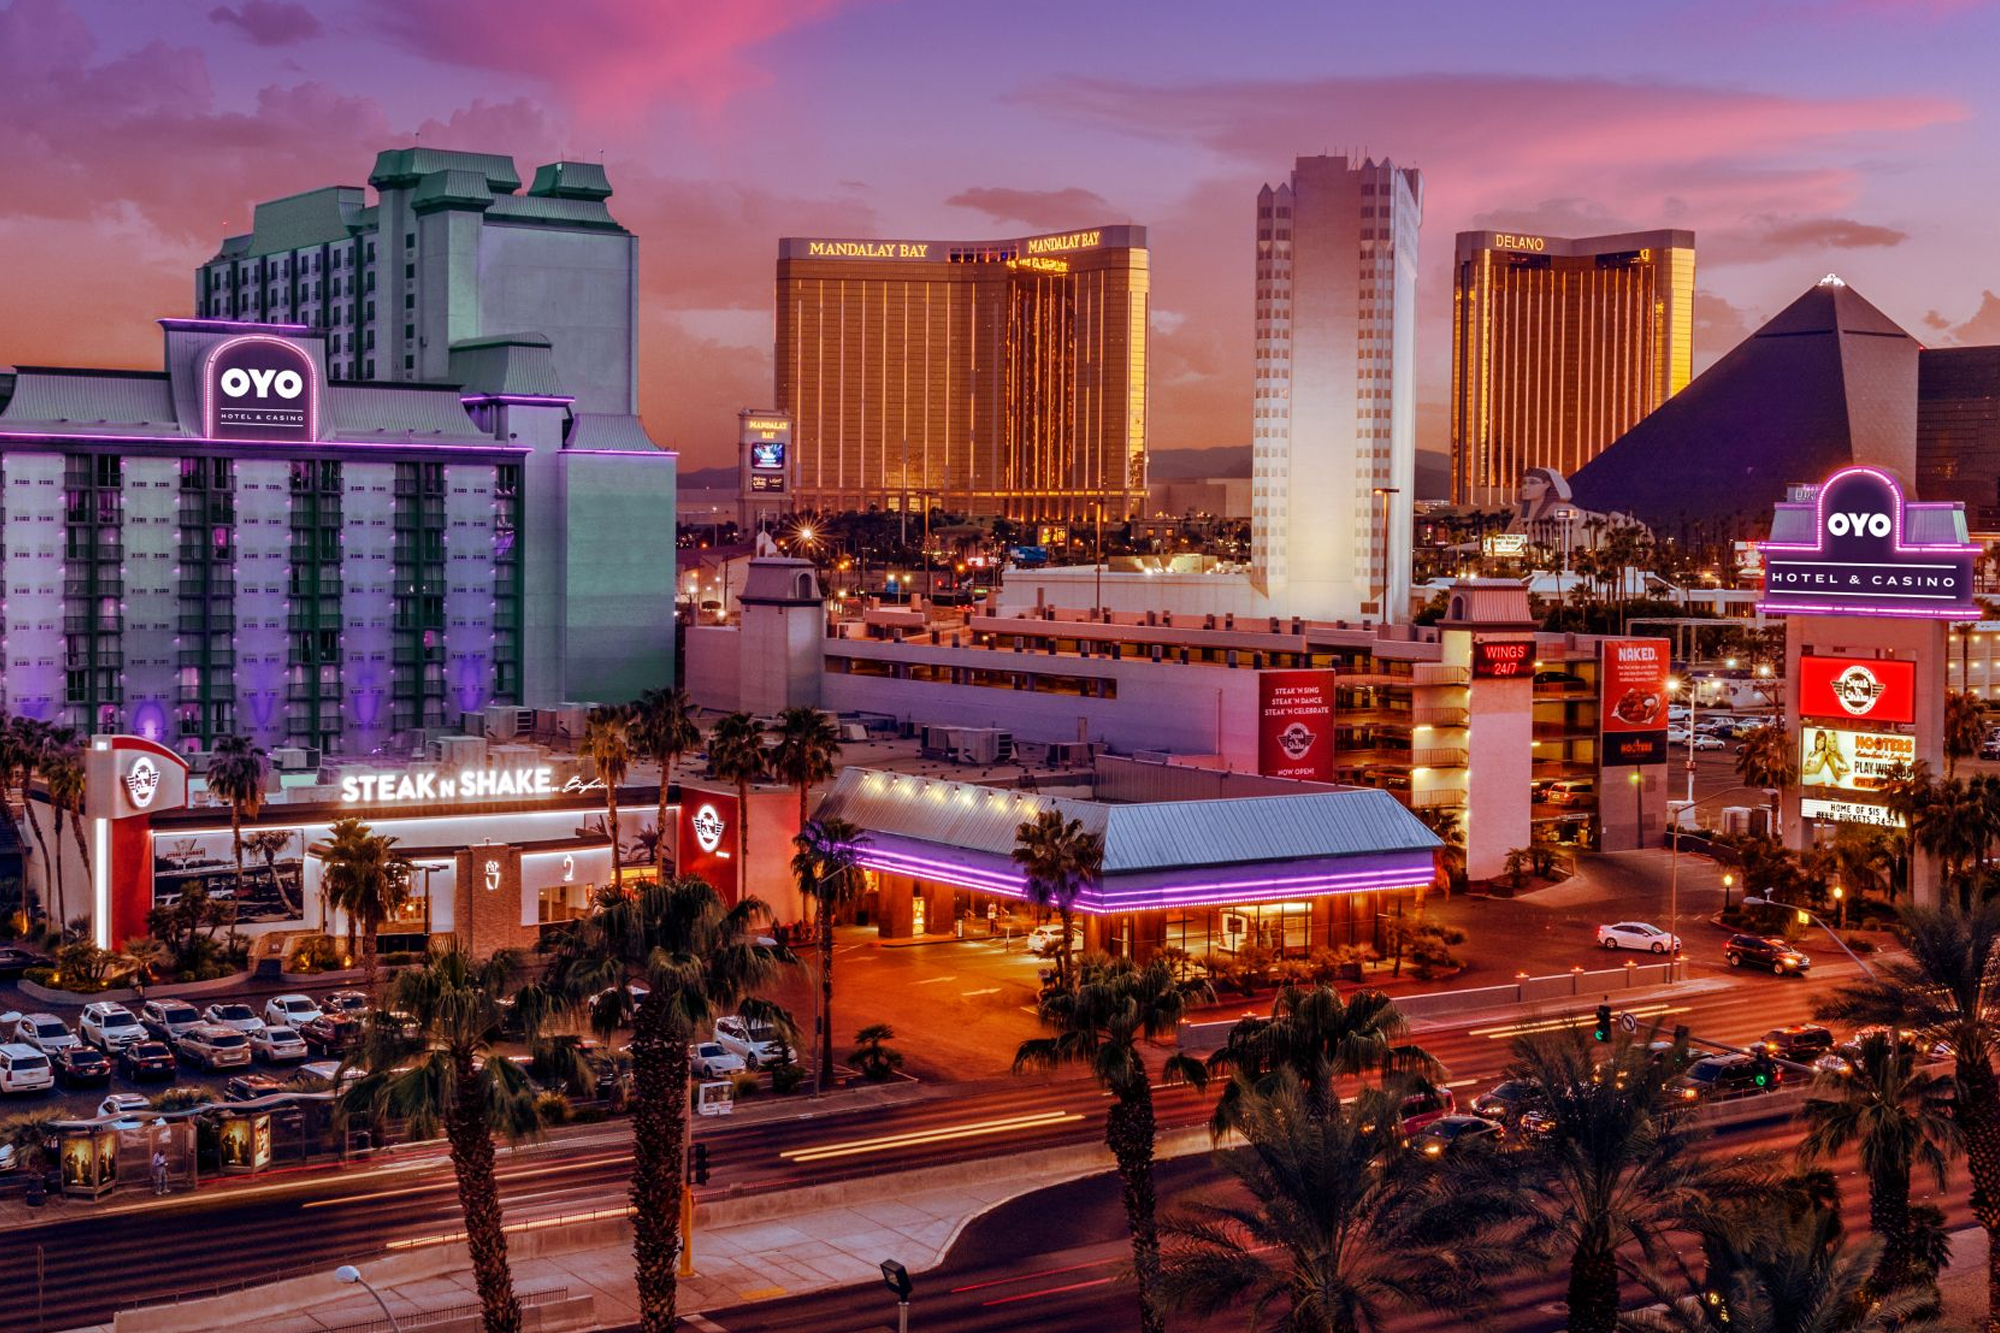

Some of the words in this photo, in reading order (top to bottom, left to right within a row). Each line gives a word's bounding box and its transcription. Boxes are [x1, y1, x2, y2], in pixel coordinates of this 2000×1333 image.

[1028, 234, 1081, 254] MANDALAY
[1082, 231, 1100, 247] BAY
[1495, 234, 1544, 251] DELANO
[809, 242, 896, 257] MANDALAY
[899, 243, 928, 258] BAY
[221, 368, 303, 399] OYO
[265, 413, 304, 421] CASINO
[749, 420, 788, 430] MANDALAY
[761, 431, 776, 439] BAY
[1828, 512, 1891, 538] OYO
[1771, 572, 1839, 584] HOTEL
[1849, 575, 1861, 585] &
[1871, 575, 1956, 588] CASINO
[1486, 645, 1525, 659] WINGS
[1618, 647, 1658, 661] NAKED.
[1494, 662, 1517, 675] 24/7
[1275, 687, 1295, 695] STEAK
[1304, 686, 1320, 694] SING
[1272, 697, 1293, 706] STEAK
[1301, 696, 1322, 704] DANCE
[1265, 708, 1285, 716] STEAK
[1293, 706, 1329, 714] CELEBRATE
[1855, 735, 1913, 753] HOOTERS
[1277, 768, 1293, 776] NOW
[1854, 760, 1874, 774] PLAY
[341, 772, 437, 802] STEAK
[440, 779, 455, 798] N
[459, 767, 552, 796] SHAKE
[1830, 803, 1851, 813] HOME
[1855, 806, 1865, 814] OF
